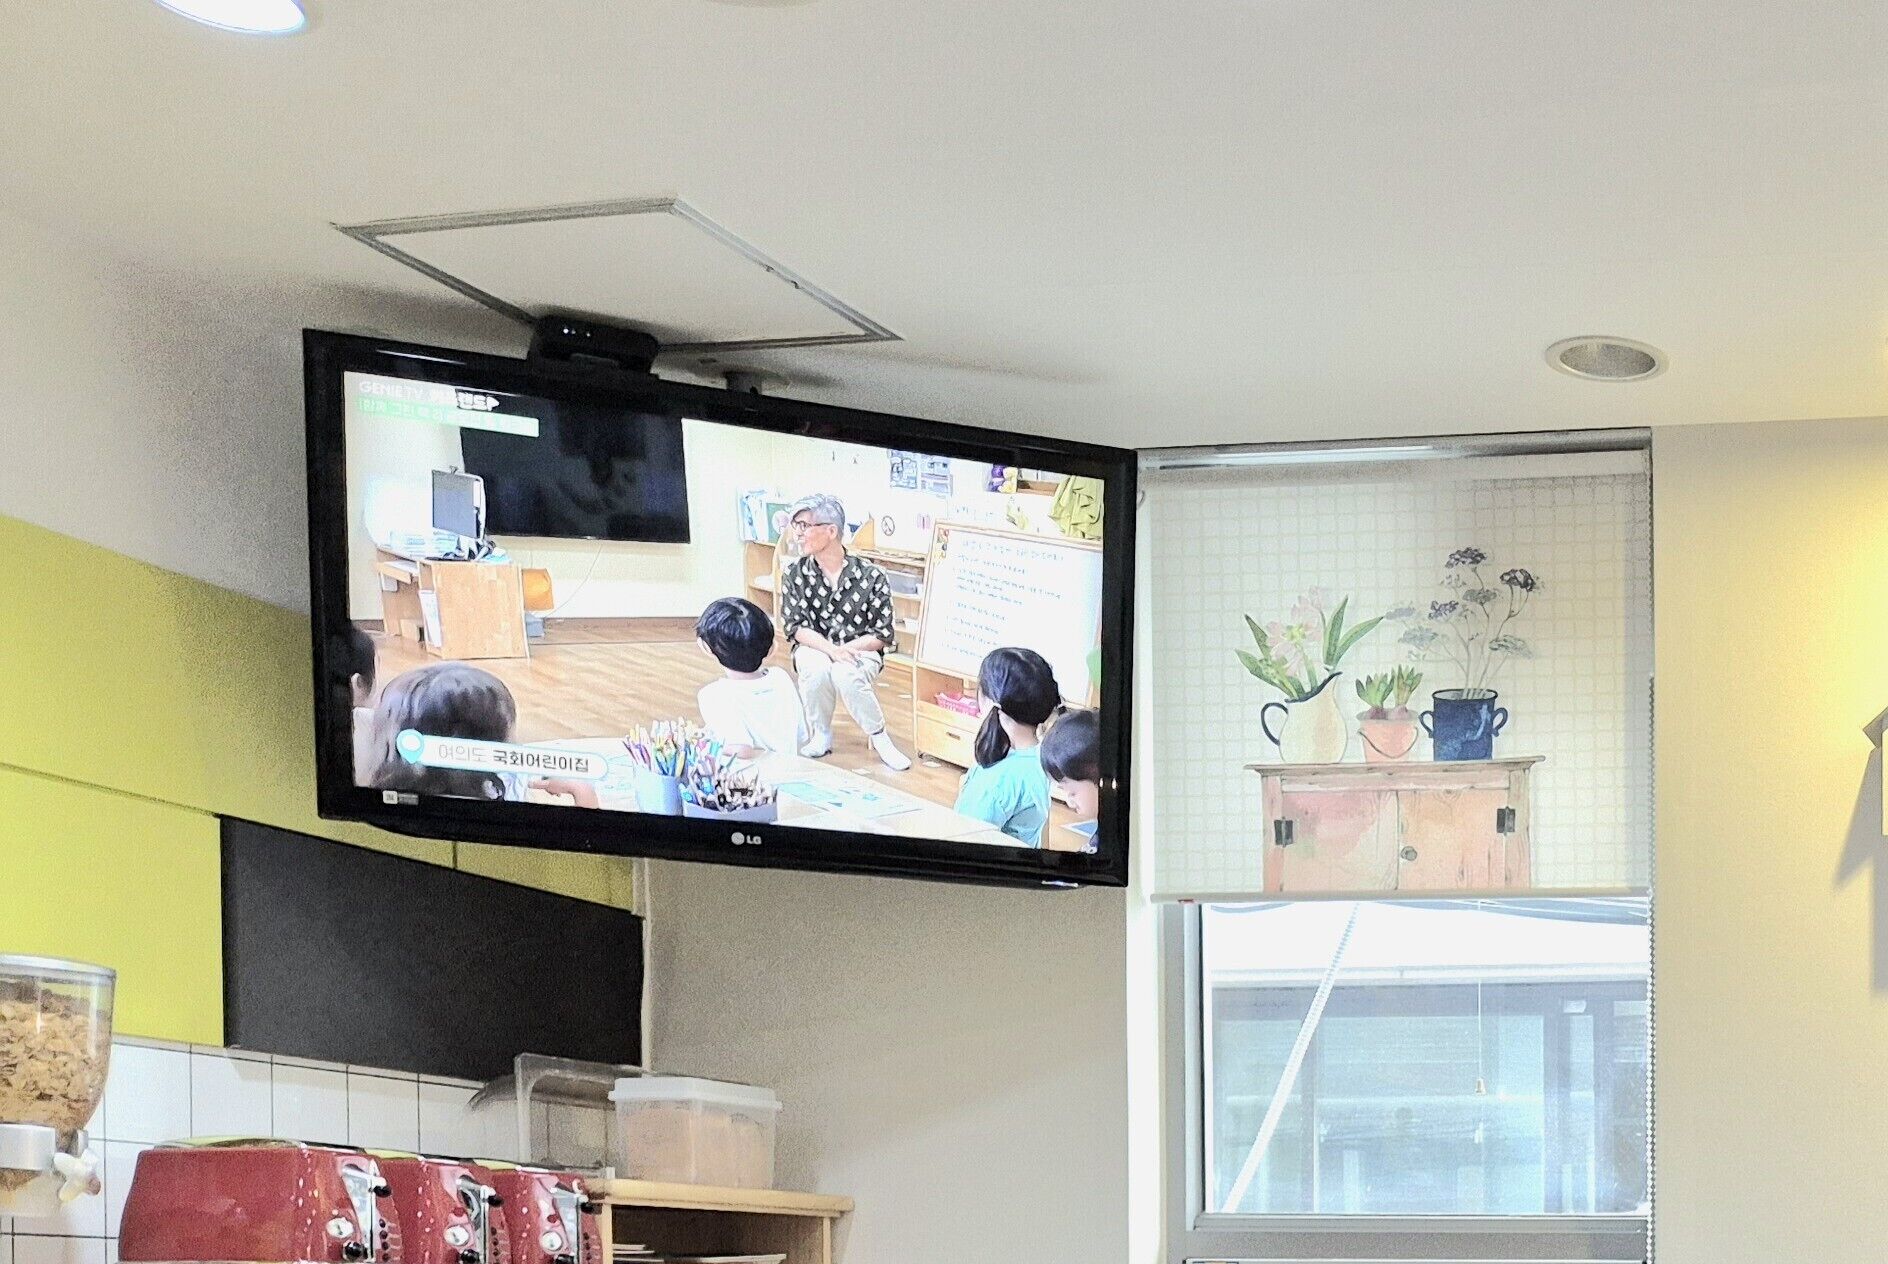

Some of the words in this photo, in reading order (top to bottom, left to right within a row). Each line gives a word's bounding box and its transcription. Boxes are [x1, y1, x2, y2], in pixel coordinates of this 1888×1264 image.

[438, 743, 488, 763] 여의도
[493, 749, 590, 773] 국회어린이집
[746, 834, 762, 845] LG
